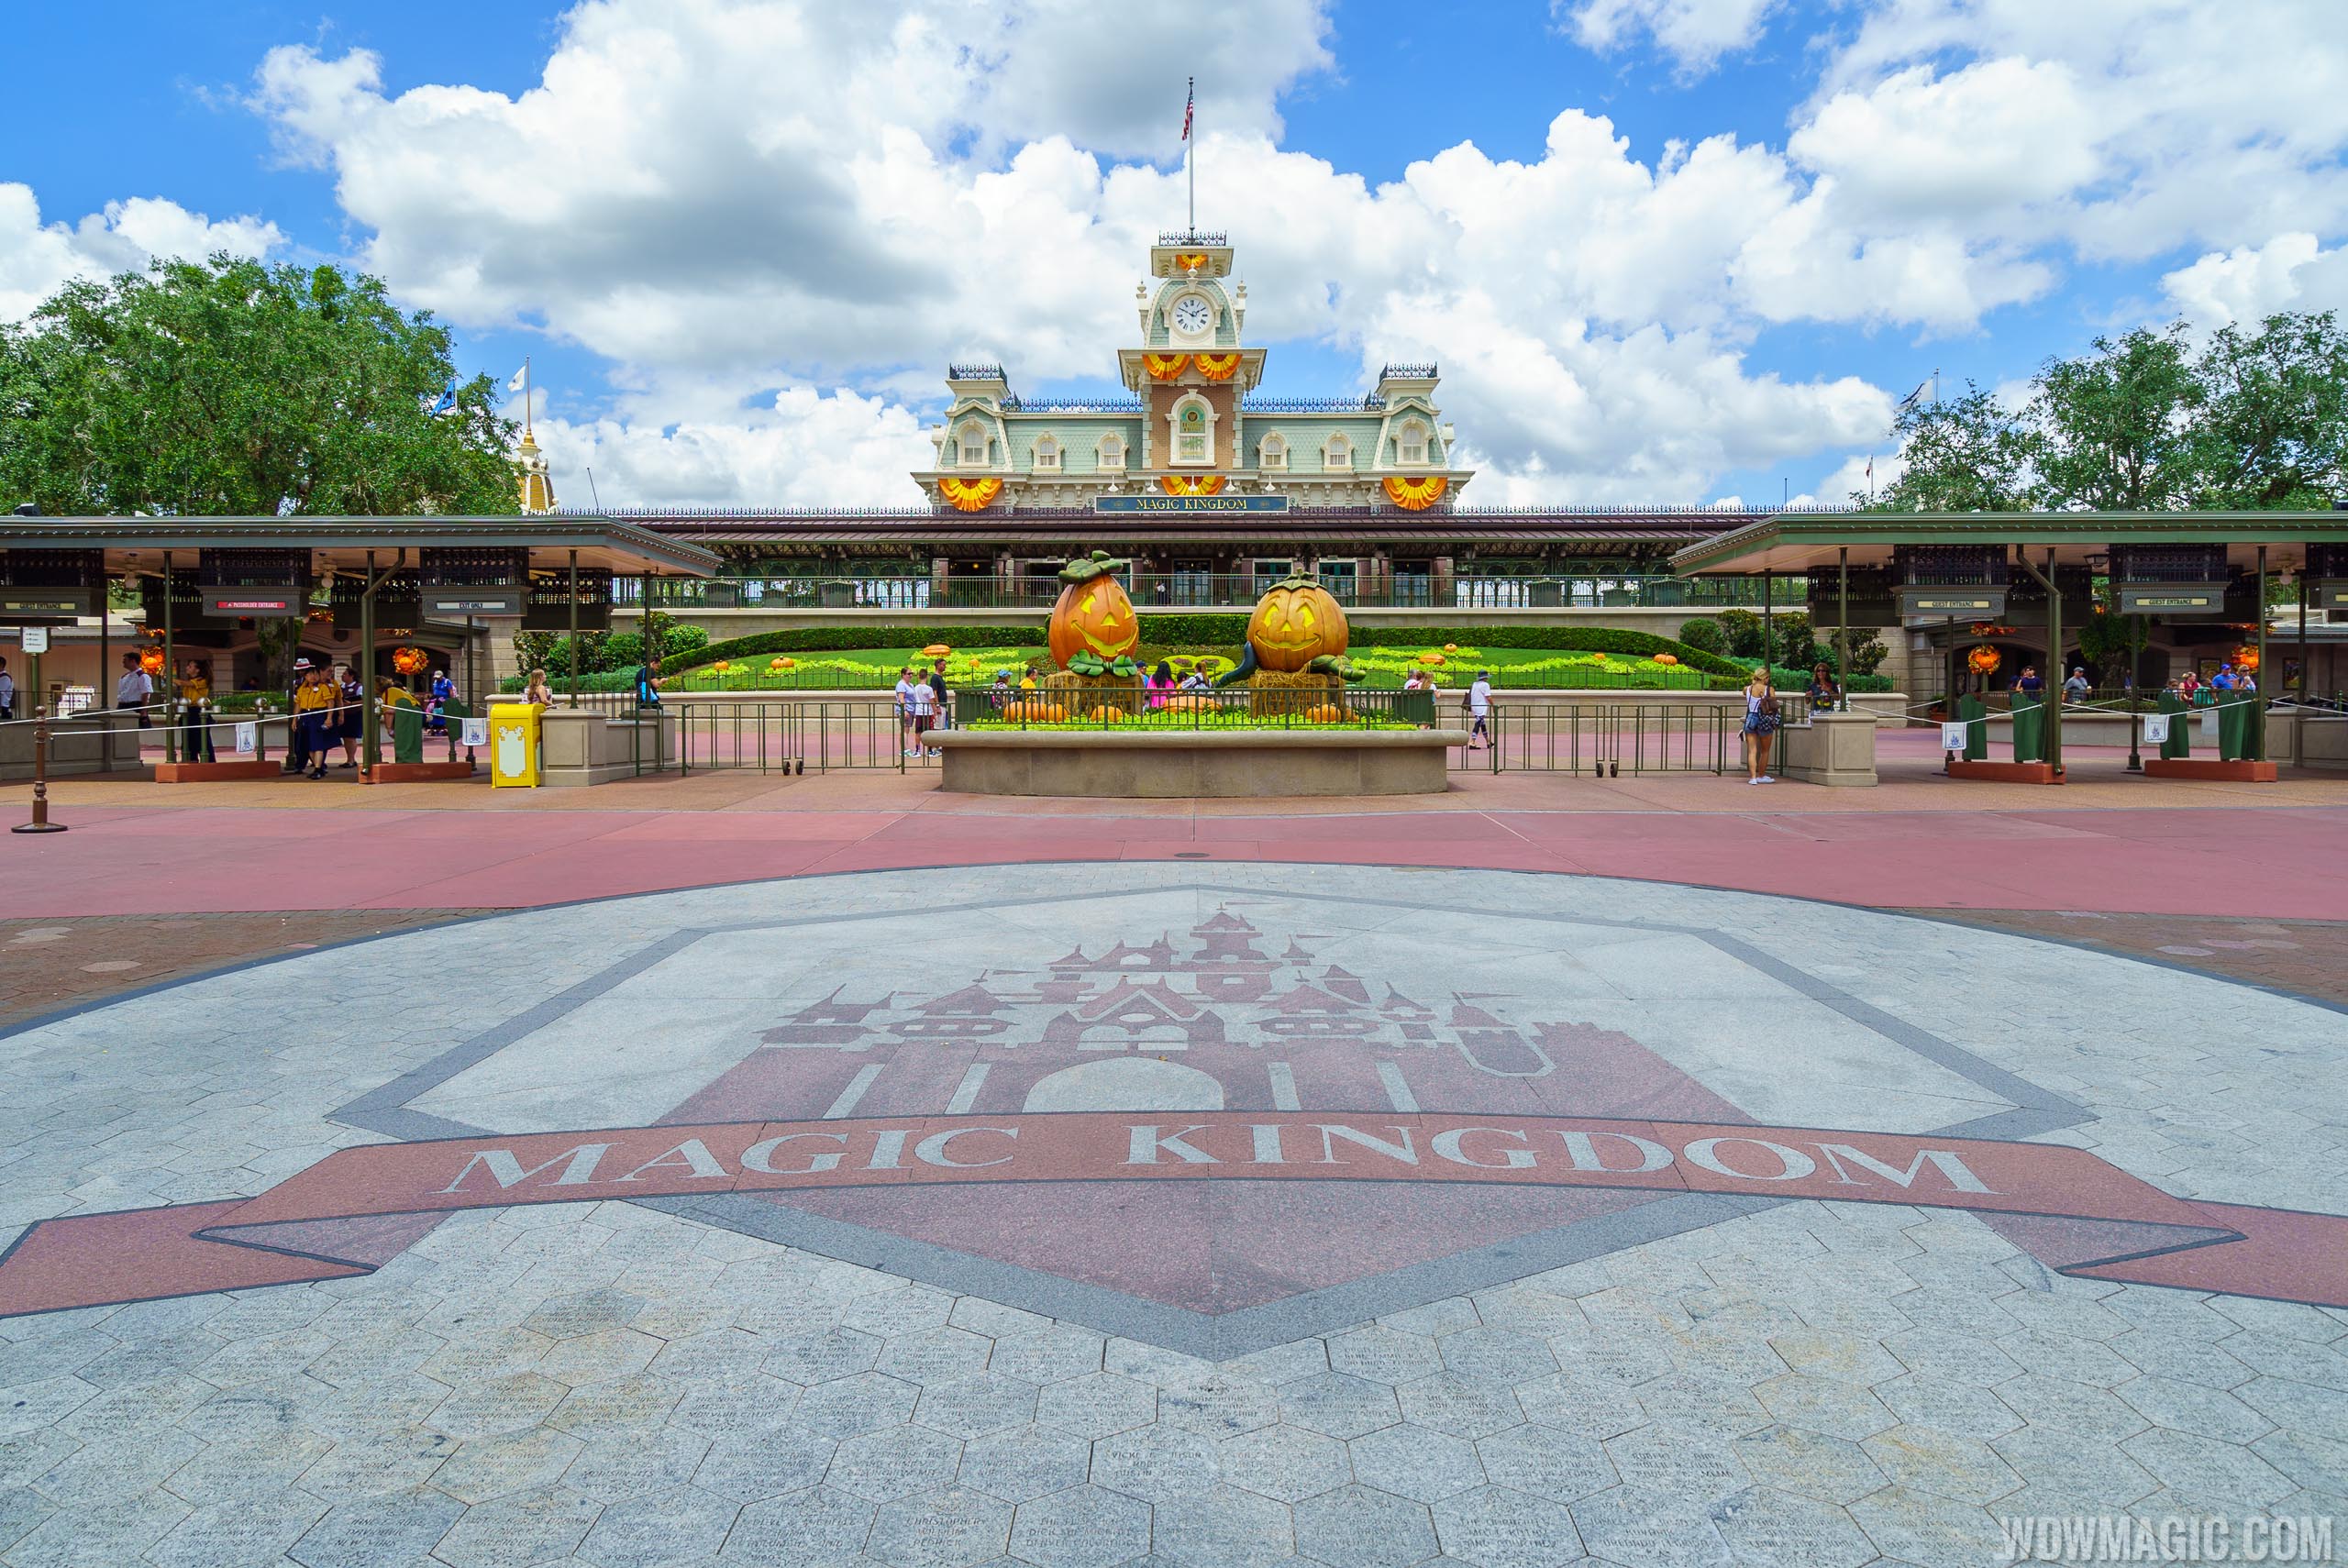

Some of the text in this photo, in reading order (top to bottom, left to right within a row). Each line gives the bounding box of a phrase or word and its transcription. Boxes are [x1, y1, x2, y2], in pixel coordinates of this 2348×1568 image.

[1135, 498, 1180, 511] MAGIC
[1184, 498, 1247, 511] KINGDOM
[2149, 598, 2192, 606] GUEST ENTRANCE
[426, 1124, 2010, 1196] MAGIC KINGDOM
